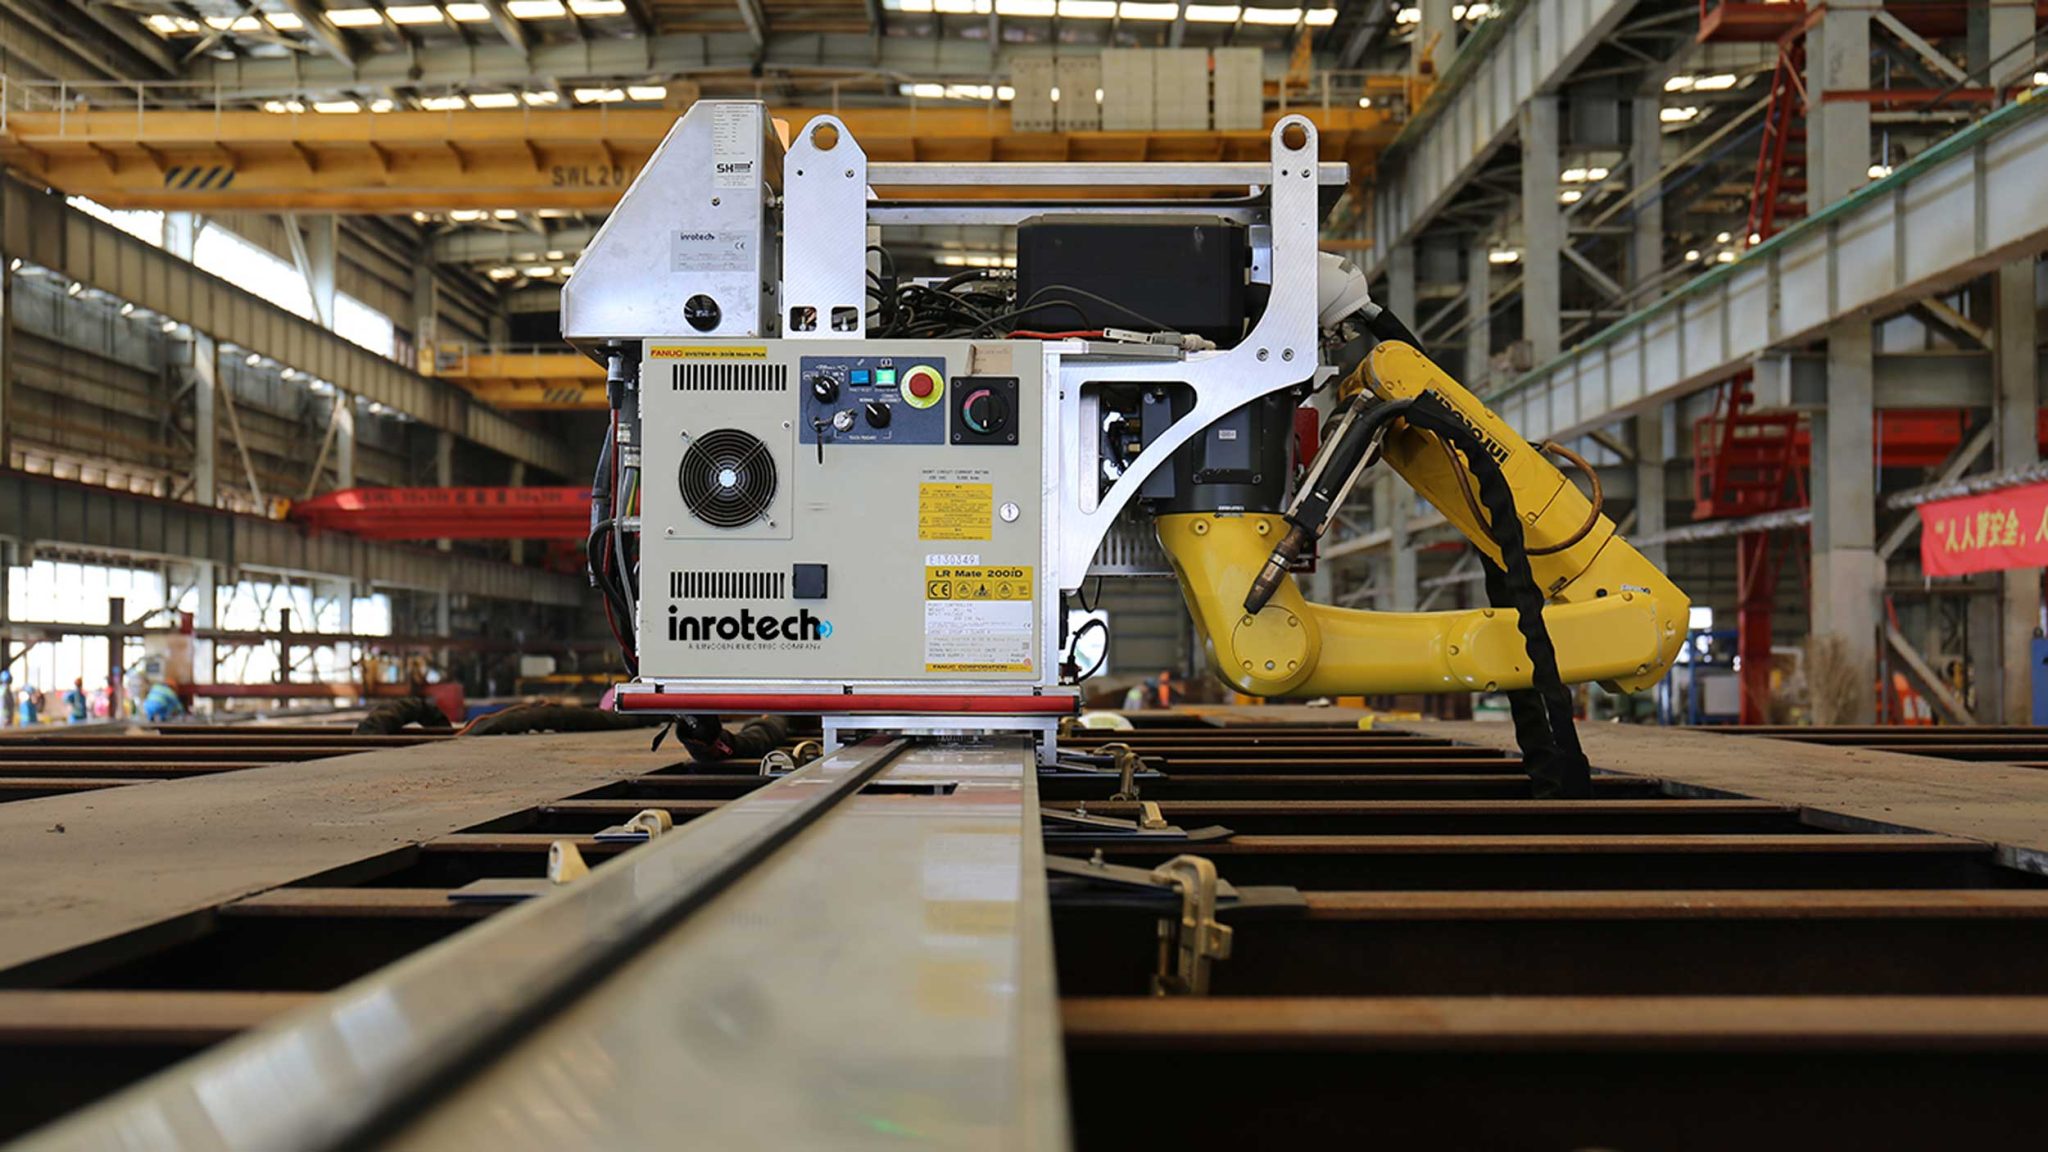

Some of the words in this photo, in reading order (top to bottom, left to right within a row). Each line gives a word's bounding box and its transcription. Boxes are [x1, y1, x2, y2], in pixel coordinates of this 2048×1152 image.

[650, 350, 683, 358] FANUC
[935, 570, 951, 578] LR
[955, 570, 982, 578] Mate
[987, 567, 1023, 578] 200iD
[668, 605, 823, 641] inrotech
